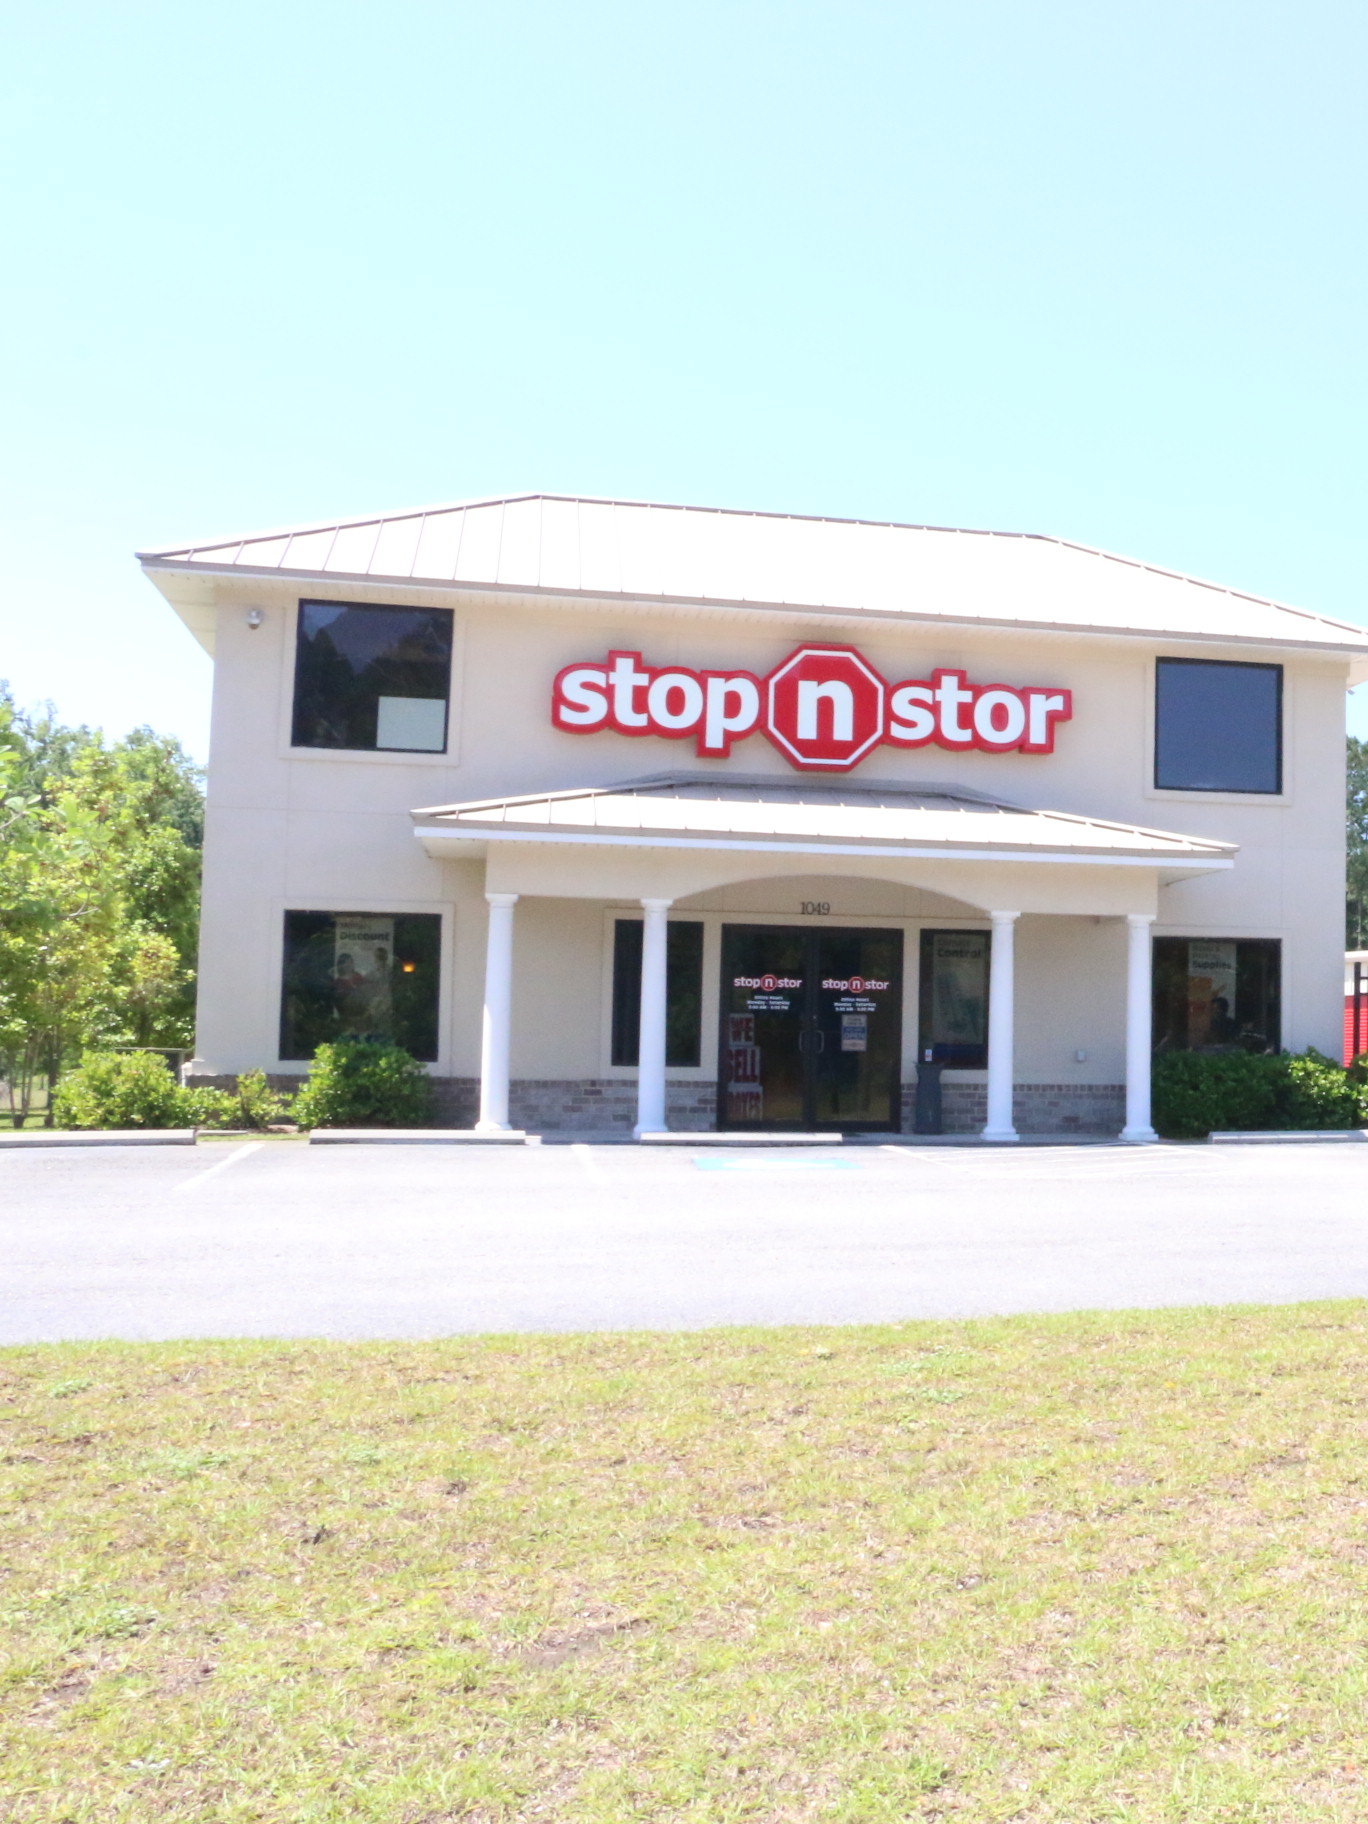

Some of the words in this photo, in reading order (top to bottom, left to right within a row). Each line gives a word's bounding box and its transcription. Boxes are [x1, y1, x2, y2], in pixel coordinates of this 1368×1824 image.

[558, 657, 760, 749] stop
[796, 680, 854, 742] n
[890, 675, 1064, 745] stor
[800, 901, 830, 916] 1049
[339, 931, 390, 942] Discount
[937, 948, 982, 958] Control
[734, 977, 761, 989] stop
[777, 977, 803, 988] stor
[822, 978, 849, 991] stop
[864, 979, 890, 990] stor
